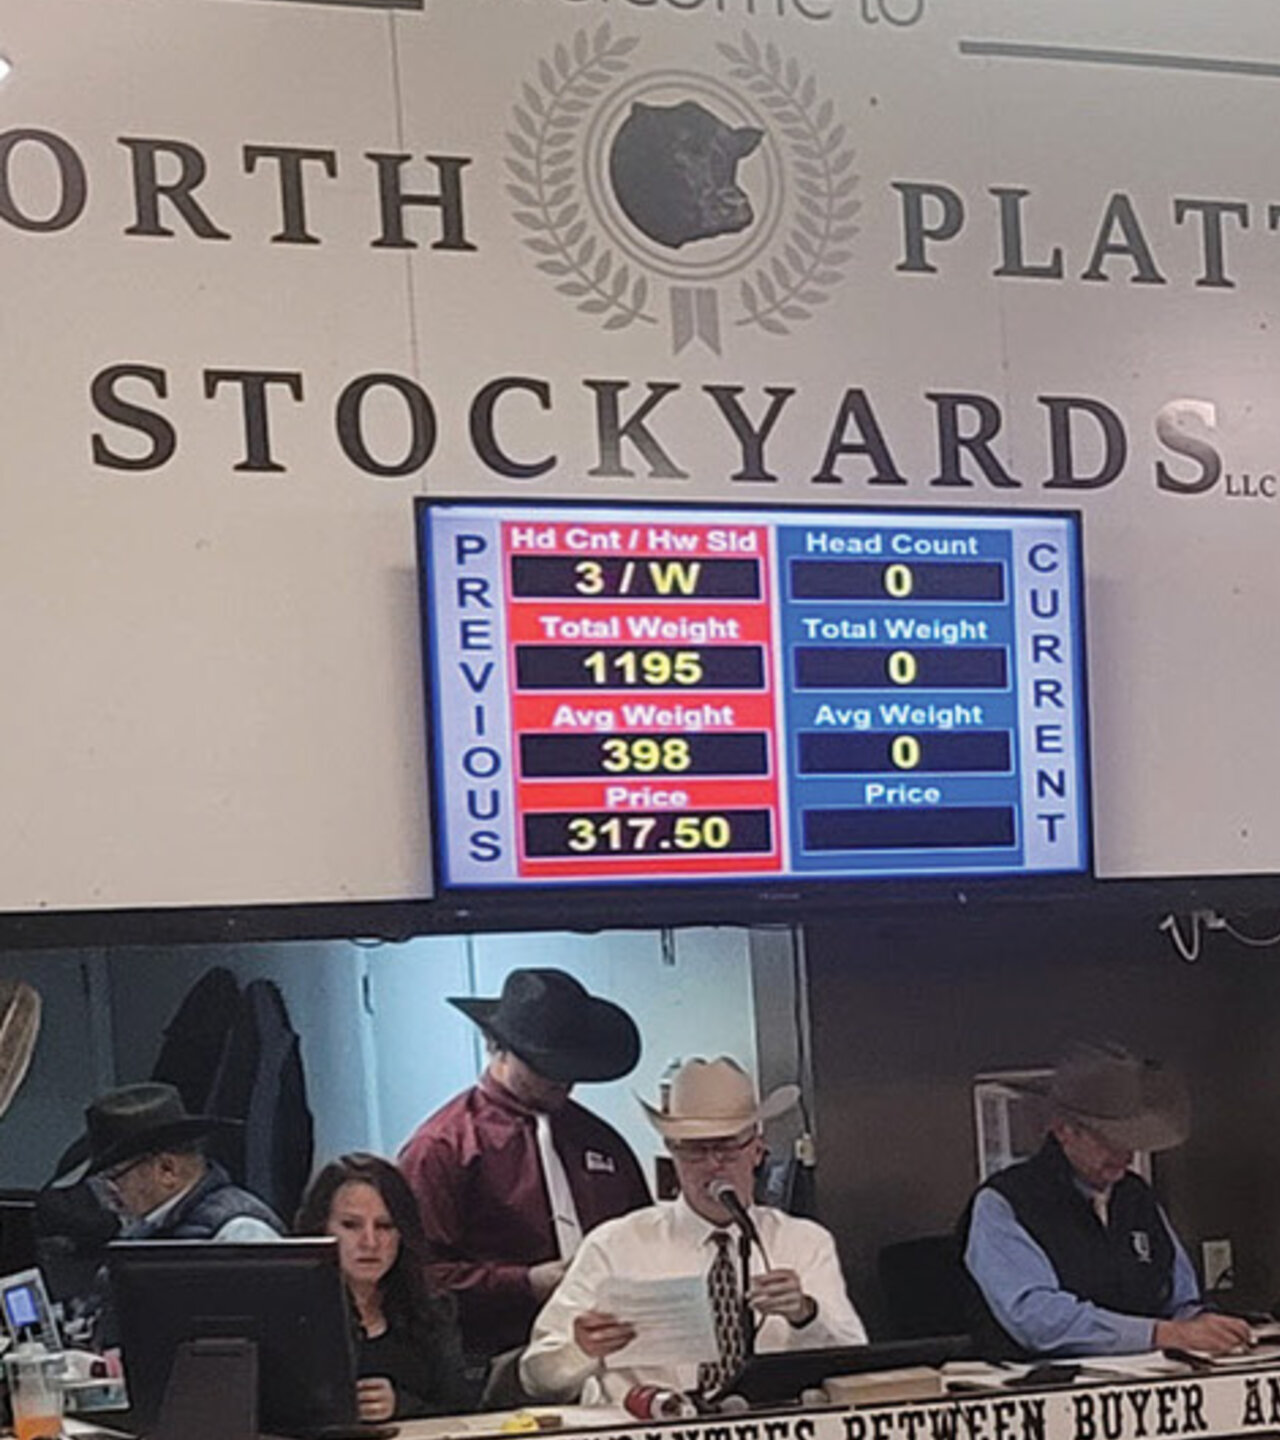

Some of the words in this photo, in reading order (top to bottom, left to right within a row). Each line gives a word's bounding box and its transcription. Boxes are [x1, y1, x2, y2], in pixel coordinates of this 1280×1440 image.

[88, 363, 1224, 495] STOCKYARDS
[1225, 474, 1277, 498] LLC
[511, 528, 556, 550] Hd
[566, 528, 622, 550] Cnt
[648, 530, 698, 551] Hw
[707, 531, 757, 553] Sld
[806, 531, 882, 553] Head
[891, 533, 978, 555] Count
[575, 561, 604, 594] 3
[619, 562, 635, 594] /
[649, 562, 700, 595] W
[884, 564, 913, 598] 0
[540, 616, 619, 639] Total
[626, 617, 739, 643] Weight
[802, 618, 876, 640] Total
[884, 619, 988, 644] Weight
[584, 651, 703, 685] 1195
[888, 650, 917, 684] 0
[455, 534, 501, 862] PREVIOUS
[1028, 543, 1065, 843] CURRENT
[553, 705, 614, 731] Avg
[622, 704, 734, 731] Weight
[814, 705, 872, 730] Avg
[879, 704, 983, 730] Weight
[602, 738, 691, 772] 398
[891, 735, 920, 769] 0
[605, 786, 688, 808] Price
[865, 782, 941, 804] Price
[568, 816, 731, 851] 317.50
